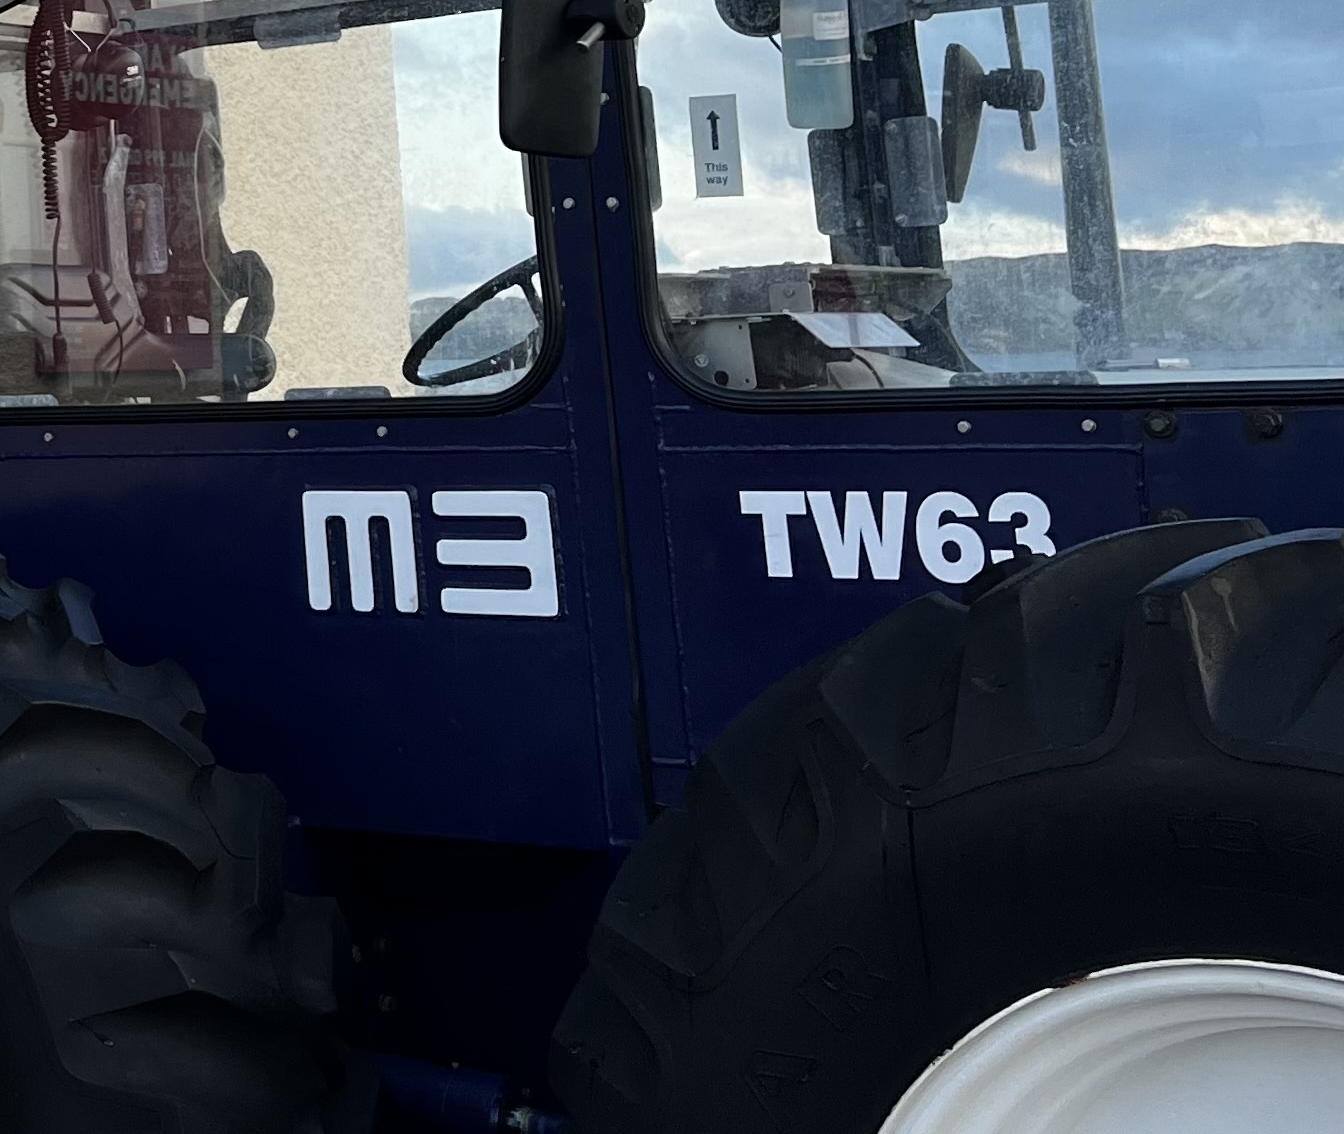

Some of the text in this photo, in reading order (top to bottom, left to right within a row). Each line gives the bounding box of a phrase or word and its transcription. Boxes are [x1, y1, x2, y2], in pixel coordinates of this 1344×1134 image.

[704, 162, 729, 172] This
[706, 175, 729, 186] way
[738, 490, 1057, 584] TW63
